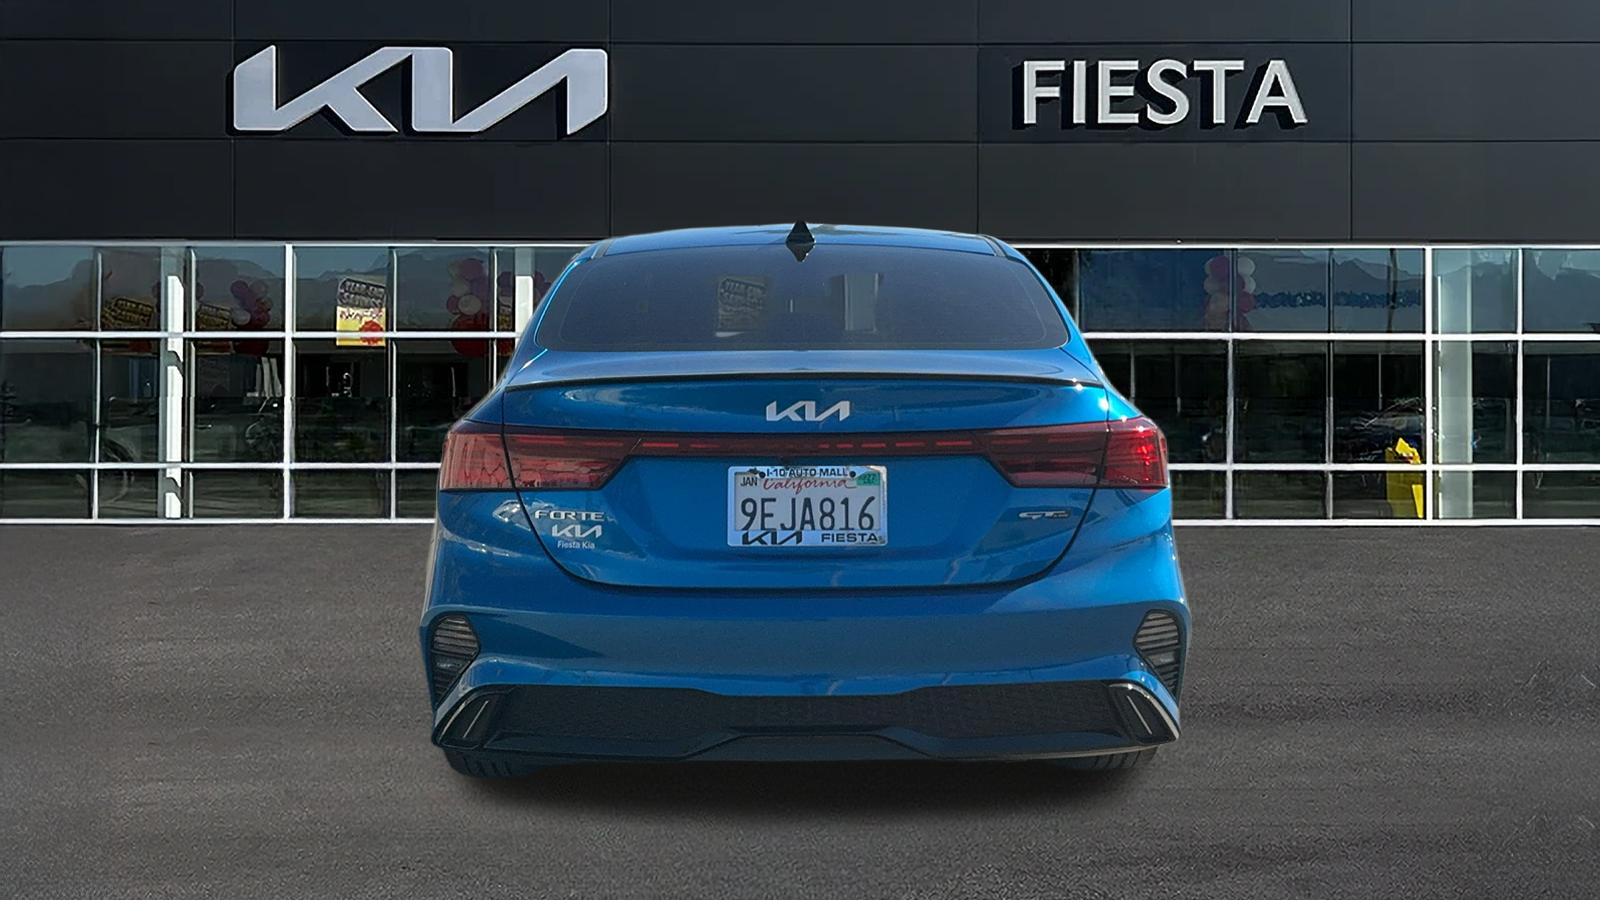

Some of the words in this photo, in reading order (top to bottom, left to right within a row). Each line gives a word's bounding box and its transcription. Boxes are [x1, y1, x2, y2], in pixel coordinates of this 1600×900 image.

[233, 45, 608, 135] KIA
[1023, 58, 1308, 125] FIESTA
[766, 400, 850, 421] KIA
[766, 468, 786, 477] I-10
[788, 468, 816, 478] AUTO
[819, 468, 848, 477] MALL
[740, 477, 758, 487] JAN
[763, 478, 857, 495] California
[535, 510, 605, 521] FORTE
[741, 496, 875, 531] 9EJA816
[552, 524, 602, 538] KIA
[742, 530, 803, 545] KIA
[821, 532, 879, 543] FIESTA
[557, 540, 580, 549] Fiesta
[582, 541, 596, 550] Kia
